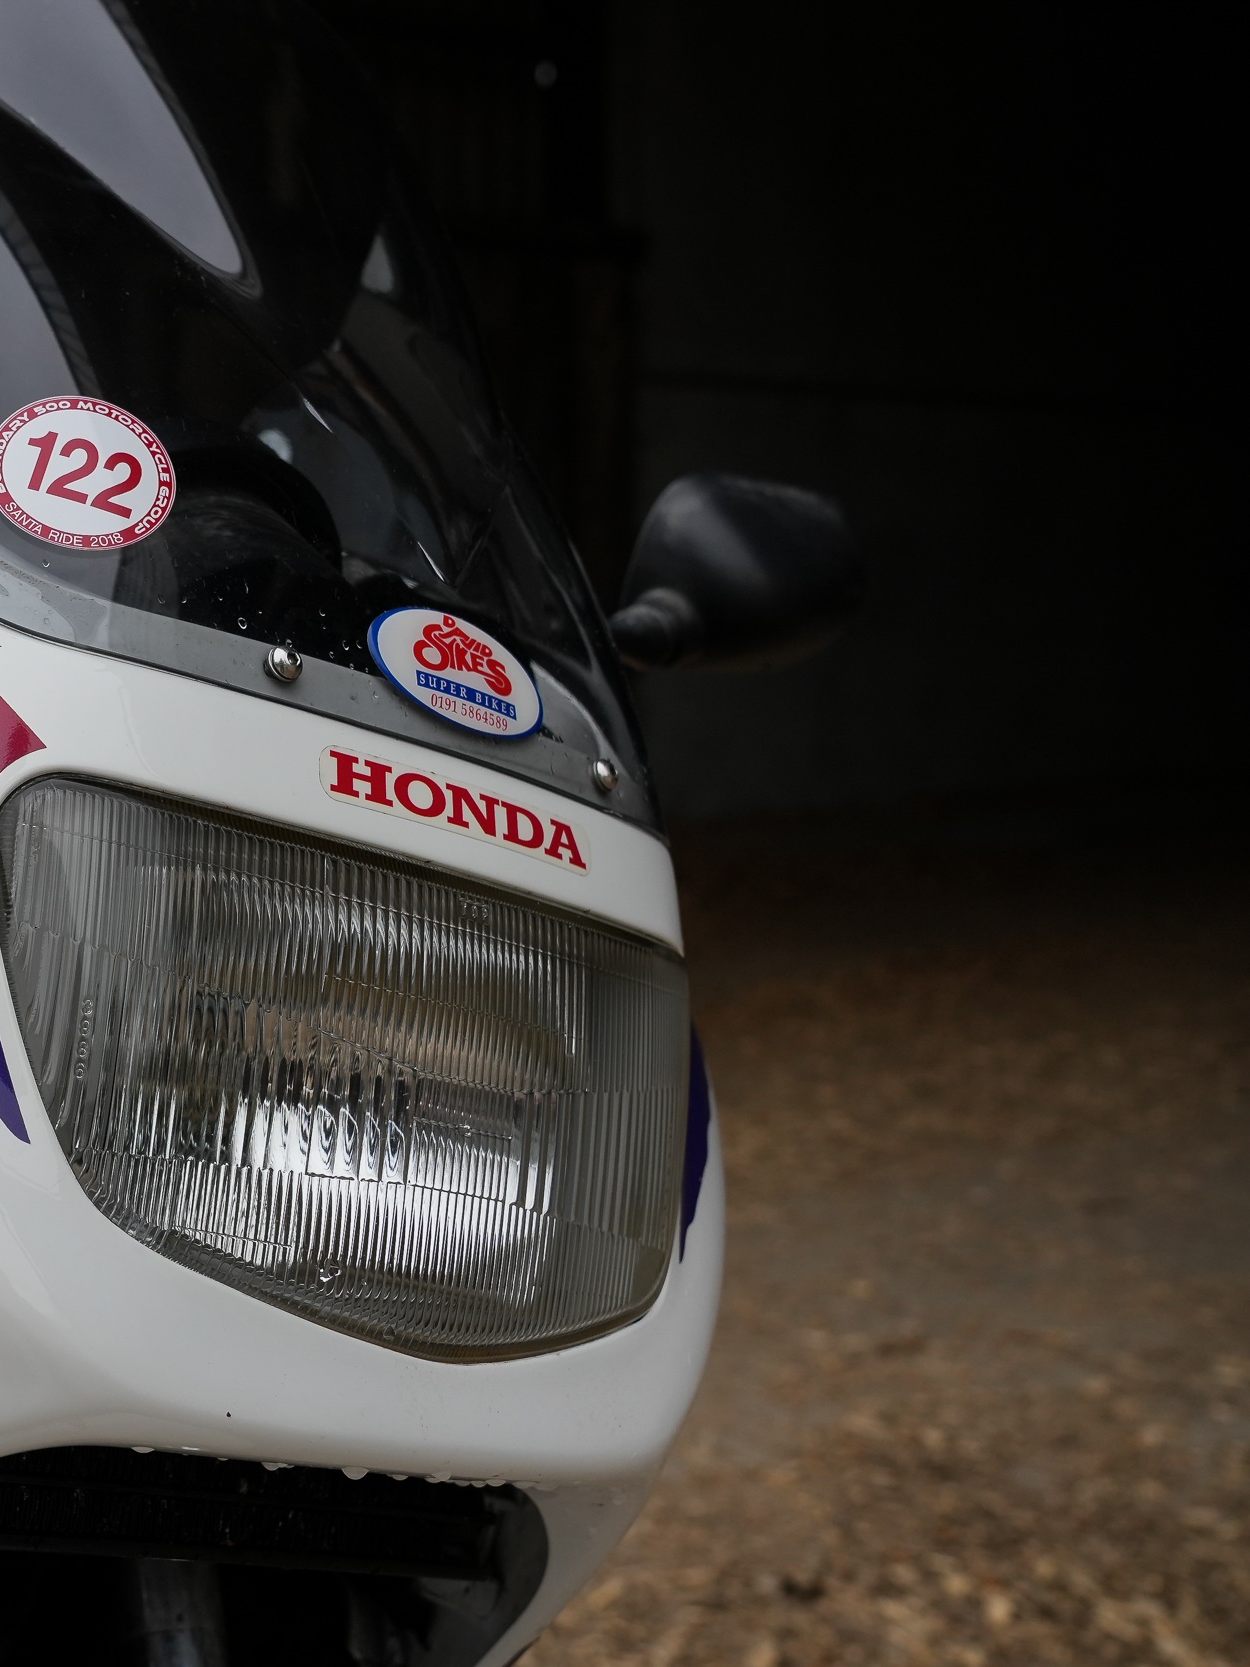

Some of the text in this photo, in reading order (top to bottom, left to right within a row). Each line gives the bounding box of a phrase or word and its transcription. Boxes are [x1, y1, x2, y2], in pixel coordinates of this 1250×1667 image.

[27, 430, 143, 520] 122
[33, 401, 71, 416] 500
[77, 401, 170, 483] MOTORCYCLE
[134, 485, 170, 534] GROUP
[5, 501, 124, 547] SANTA RIDE 2018
[419, 674, 516, 718] SUPER BIKES
[430, 693, 508, 731] 0191 5864589
[329, 749, 587, 871] HONDA
